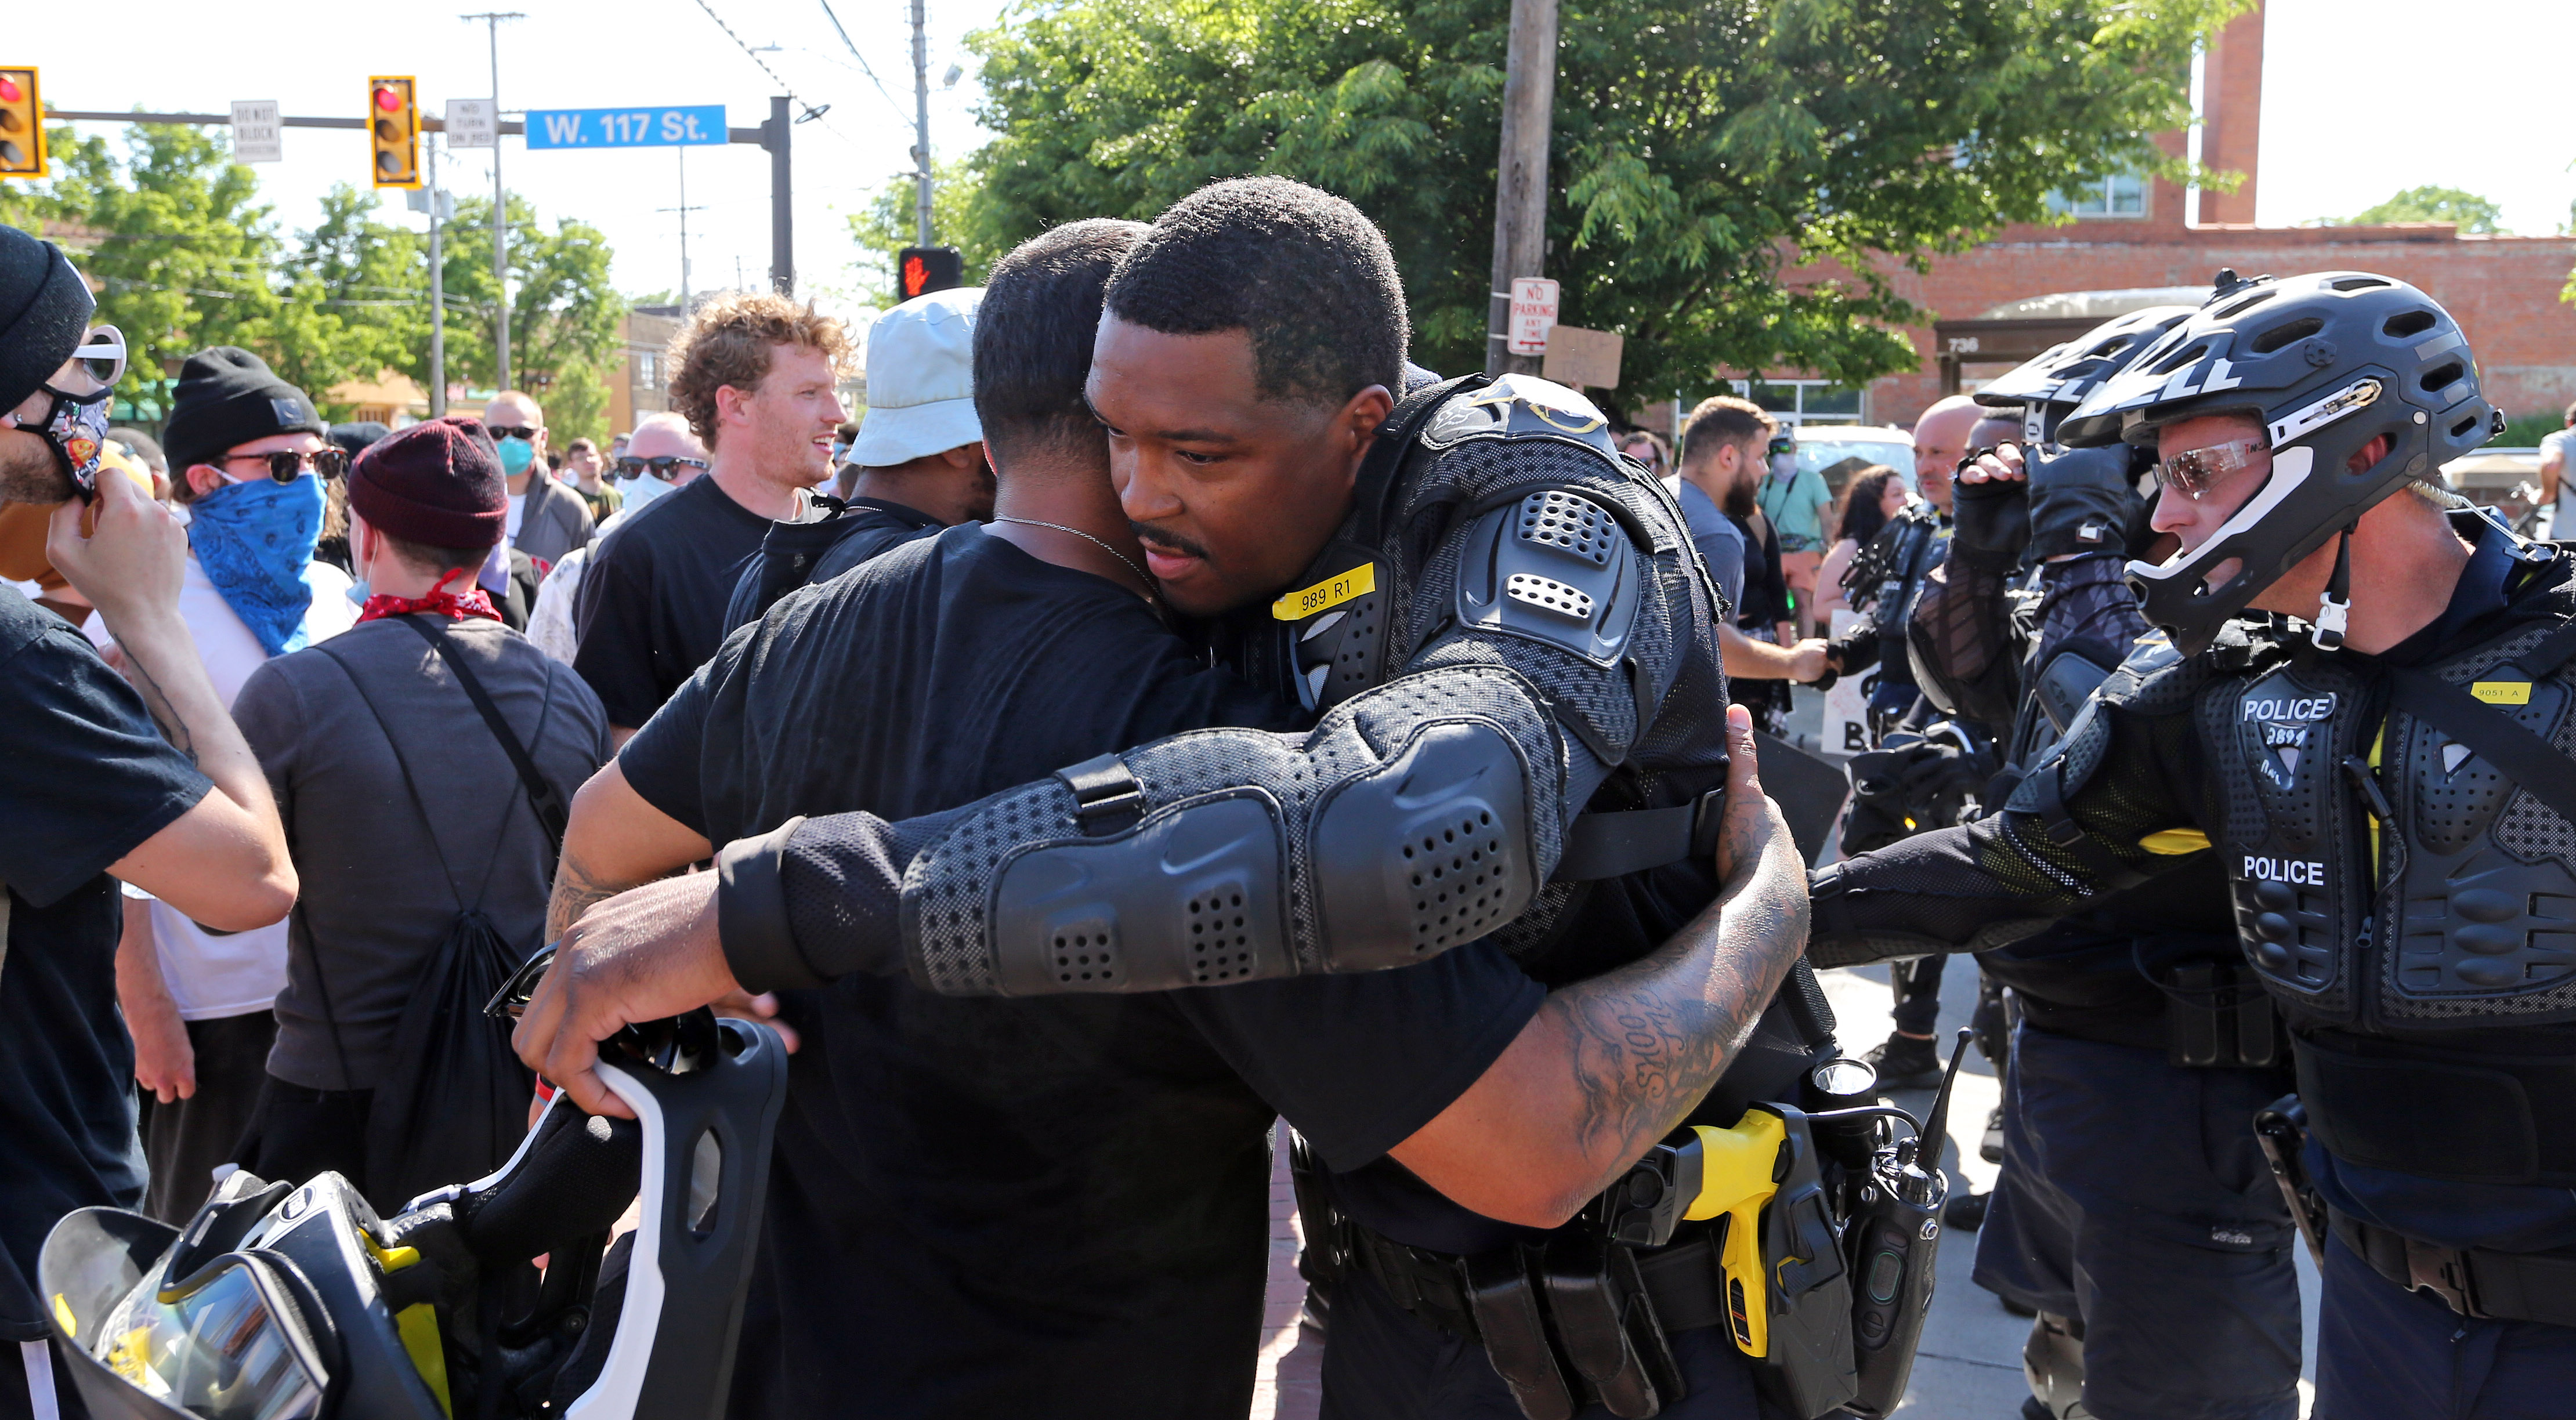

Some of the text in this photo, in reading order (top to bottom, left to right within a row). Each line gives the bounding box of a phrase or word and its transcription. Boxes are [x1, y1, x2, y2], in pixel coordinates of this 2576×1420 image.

[237, 107, 274, 122] DO NOT
[460, 103, 480, 115] NO
[456, 117, 486, 128] TURN
[544, 111, 707, 144] W. 117 St.
[238, 126, 275, 141] BLOCK
[451, 132, 466, 143] ON
[1527, 287, 1543, 300] NO
[1513, 303, 1555, 317] PARKING
[1525, 318, 1542, 327] ANY
[1524, 328, 1542, 339] TIME
[1948, 337, 1978, 353] 736
[1302, 579, 1350, 611] 989 R1
[2244, 698, 2329, 722] POLICE
[2244, 856, 2324, 886] POLICE
